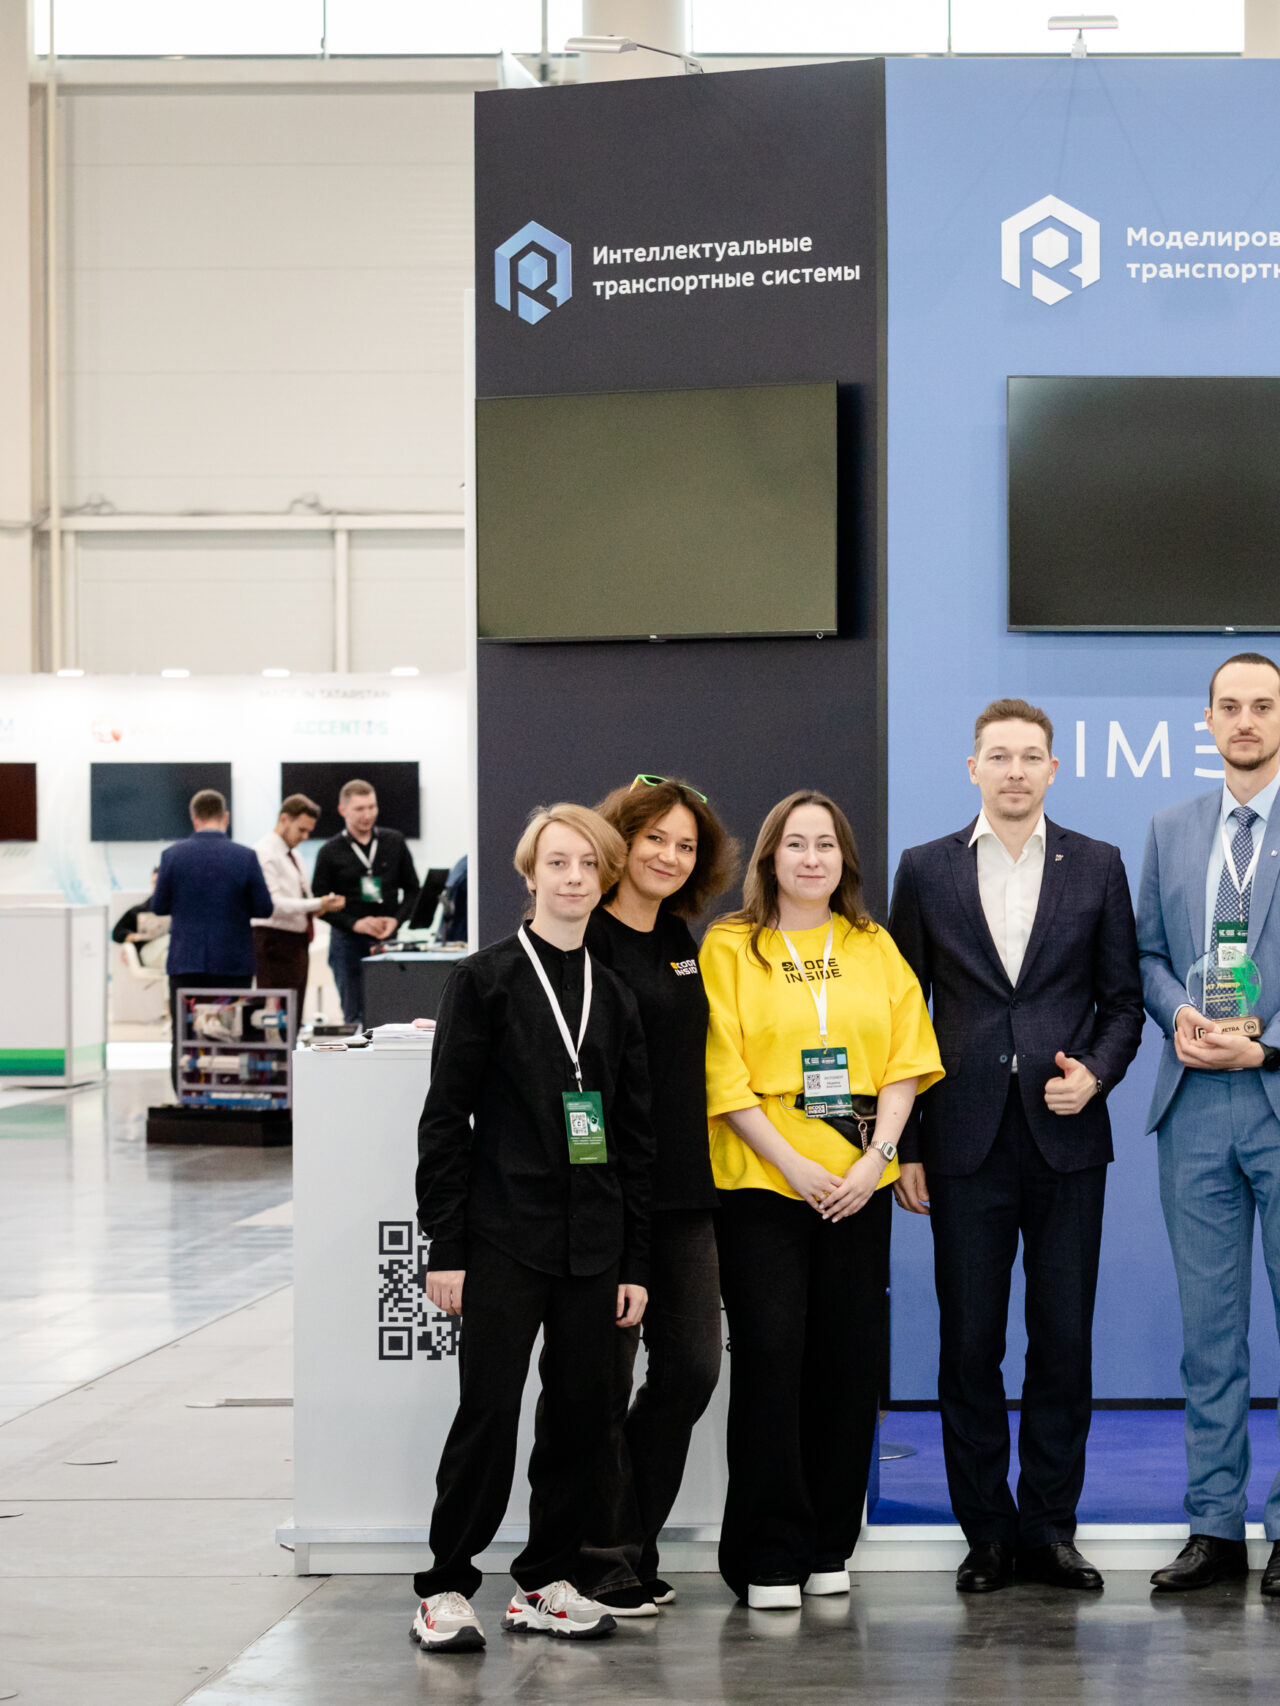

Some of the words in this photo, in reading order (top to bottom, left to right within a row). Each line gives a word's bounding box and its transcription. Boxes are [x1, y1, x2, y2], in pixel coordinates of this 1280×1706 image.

[592, 234, 813, 265] Интеллектуальные
[592, 271, 755, 300] транспортные
[761, 261, 861, 286] системы
